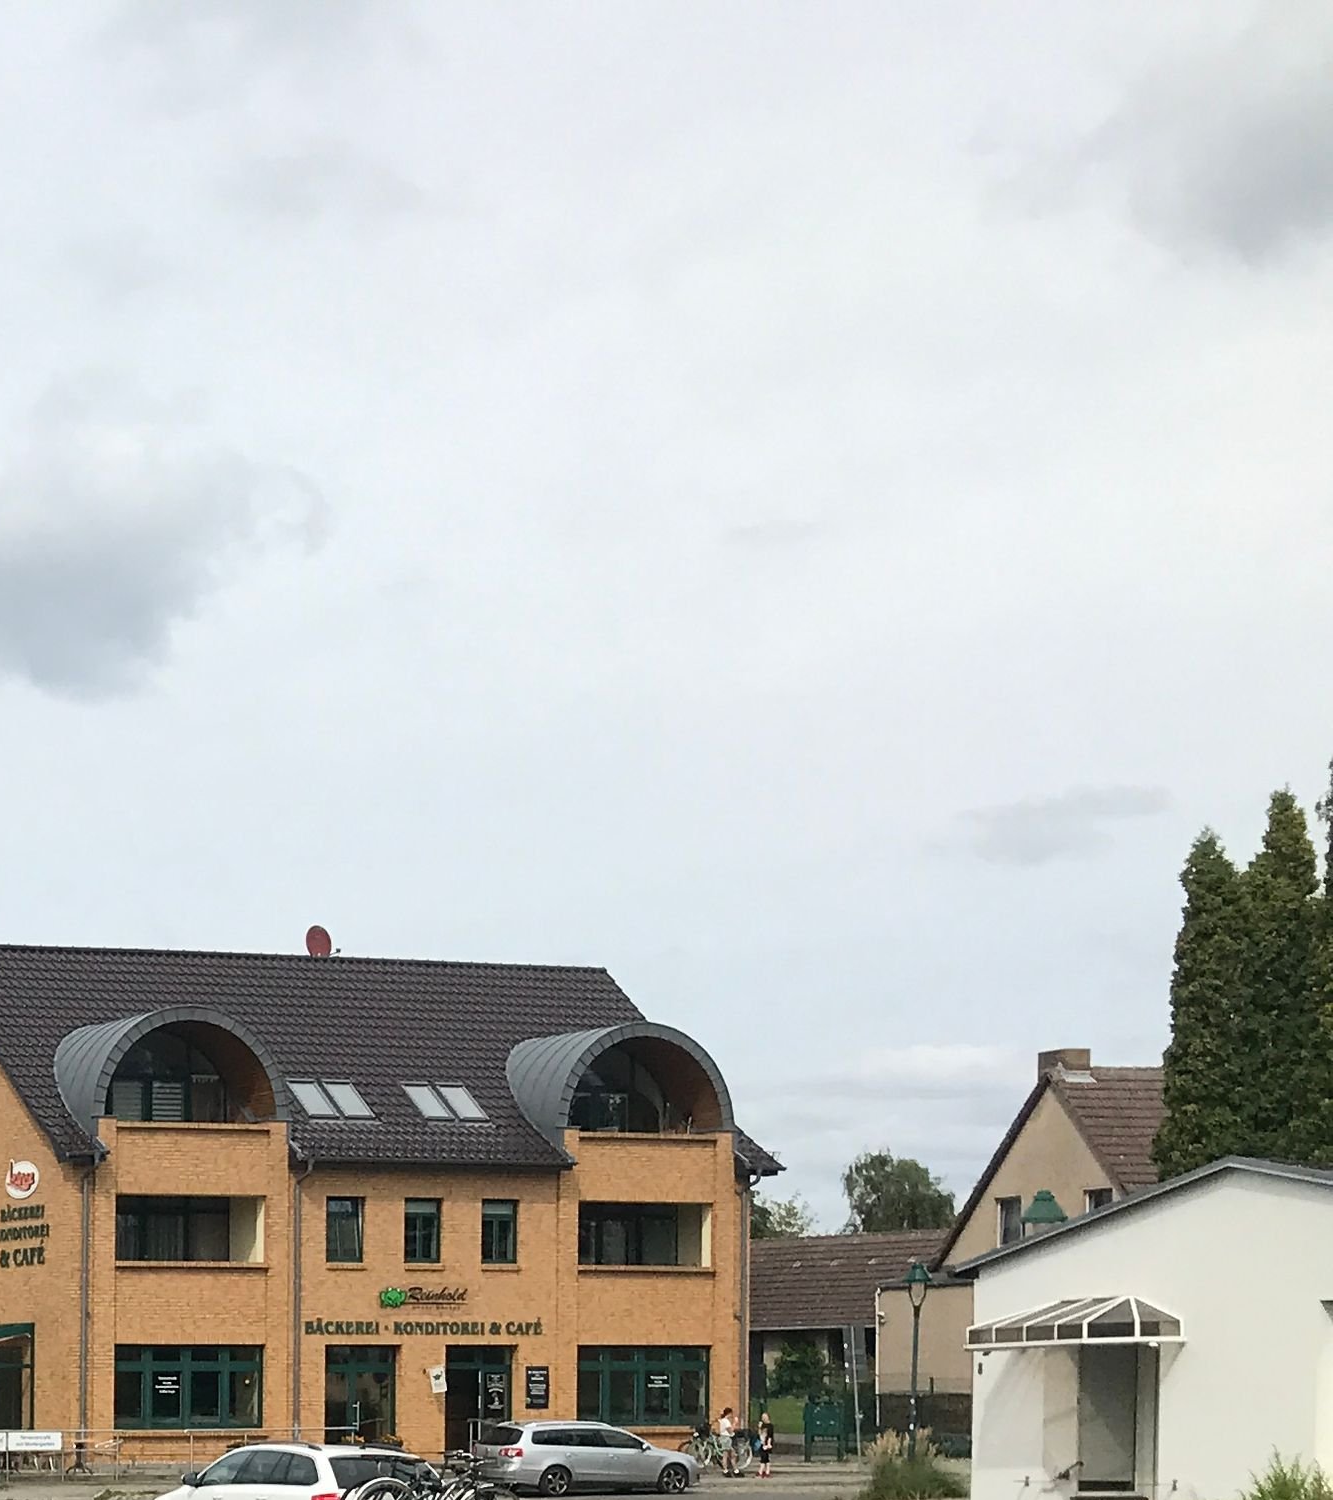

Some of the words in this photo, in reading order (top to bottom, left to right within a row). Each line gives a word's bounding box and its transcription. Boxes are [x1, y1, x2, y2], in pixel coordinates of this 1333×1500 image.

[0, 1204, 45, 1223] BÄCKEREI
[0, 1250, 10, 1268] &
[13, 1239, 45, 1267] CAFÉ
[408, 1286, 468, 1302] Reinhold
[304, 1318, 380, 1336] BÄCKEREI
[393, 1320, 485, 1336] KONDITOREI
[488, 1320, 501, 1335] &
[505, 1317, 543, 1335] CAFÉ
